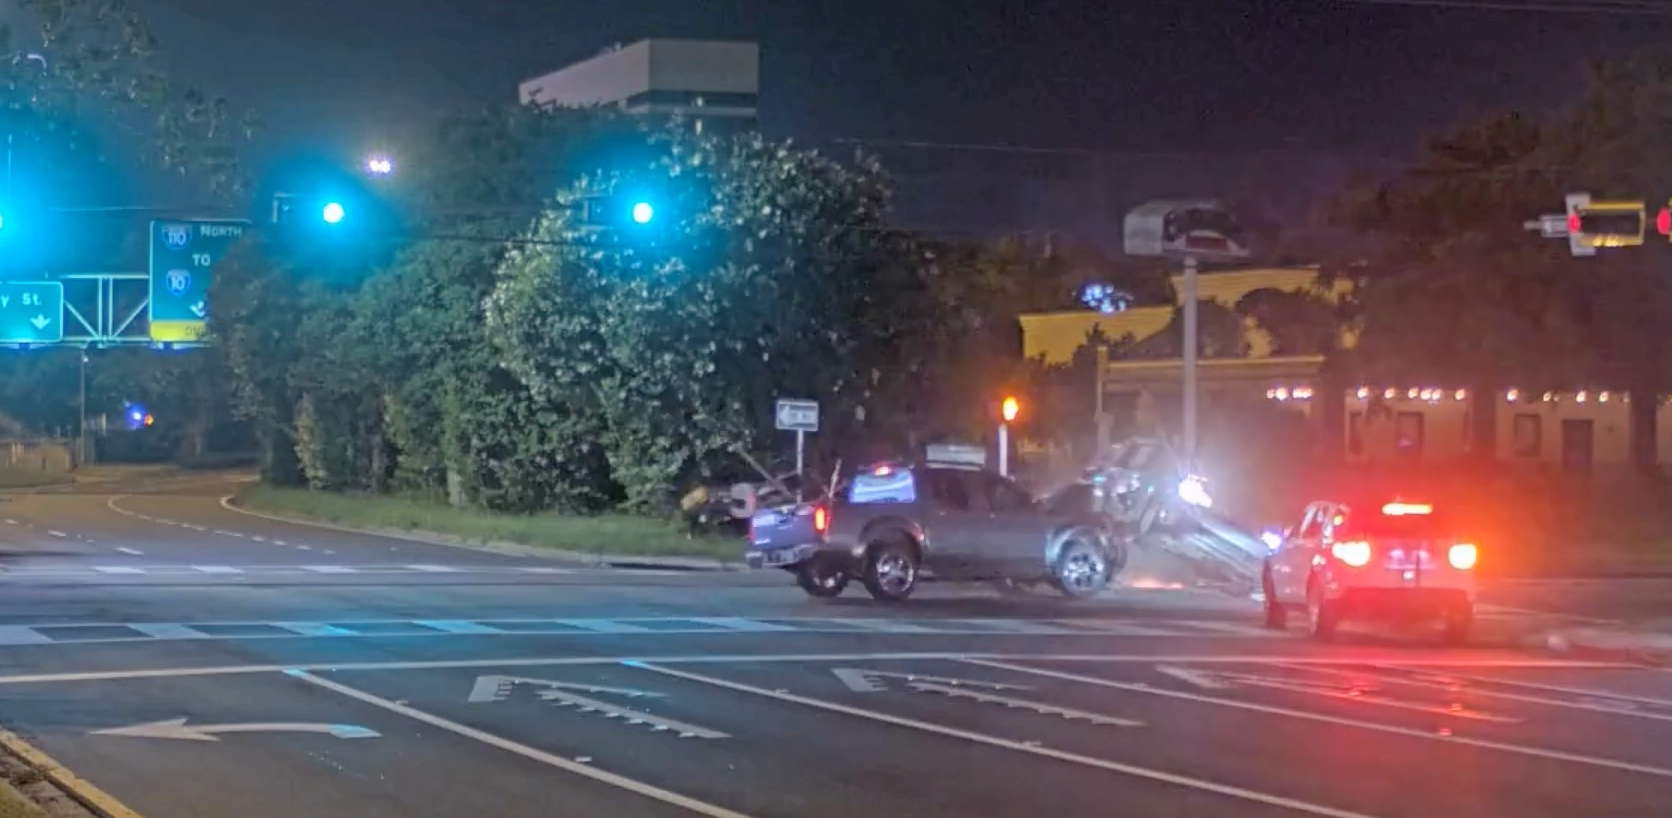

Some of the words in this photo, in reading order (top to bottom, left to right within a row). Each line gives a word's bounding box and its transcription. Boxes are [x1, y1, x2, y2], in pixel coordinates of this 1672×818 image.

[168, 231, 187, 246] 110
[192, 253, 211, 266] TO
[170, 276, 186, 291] 10
